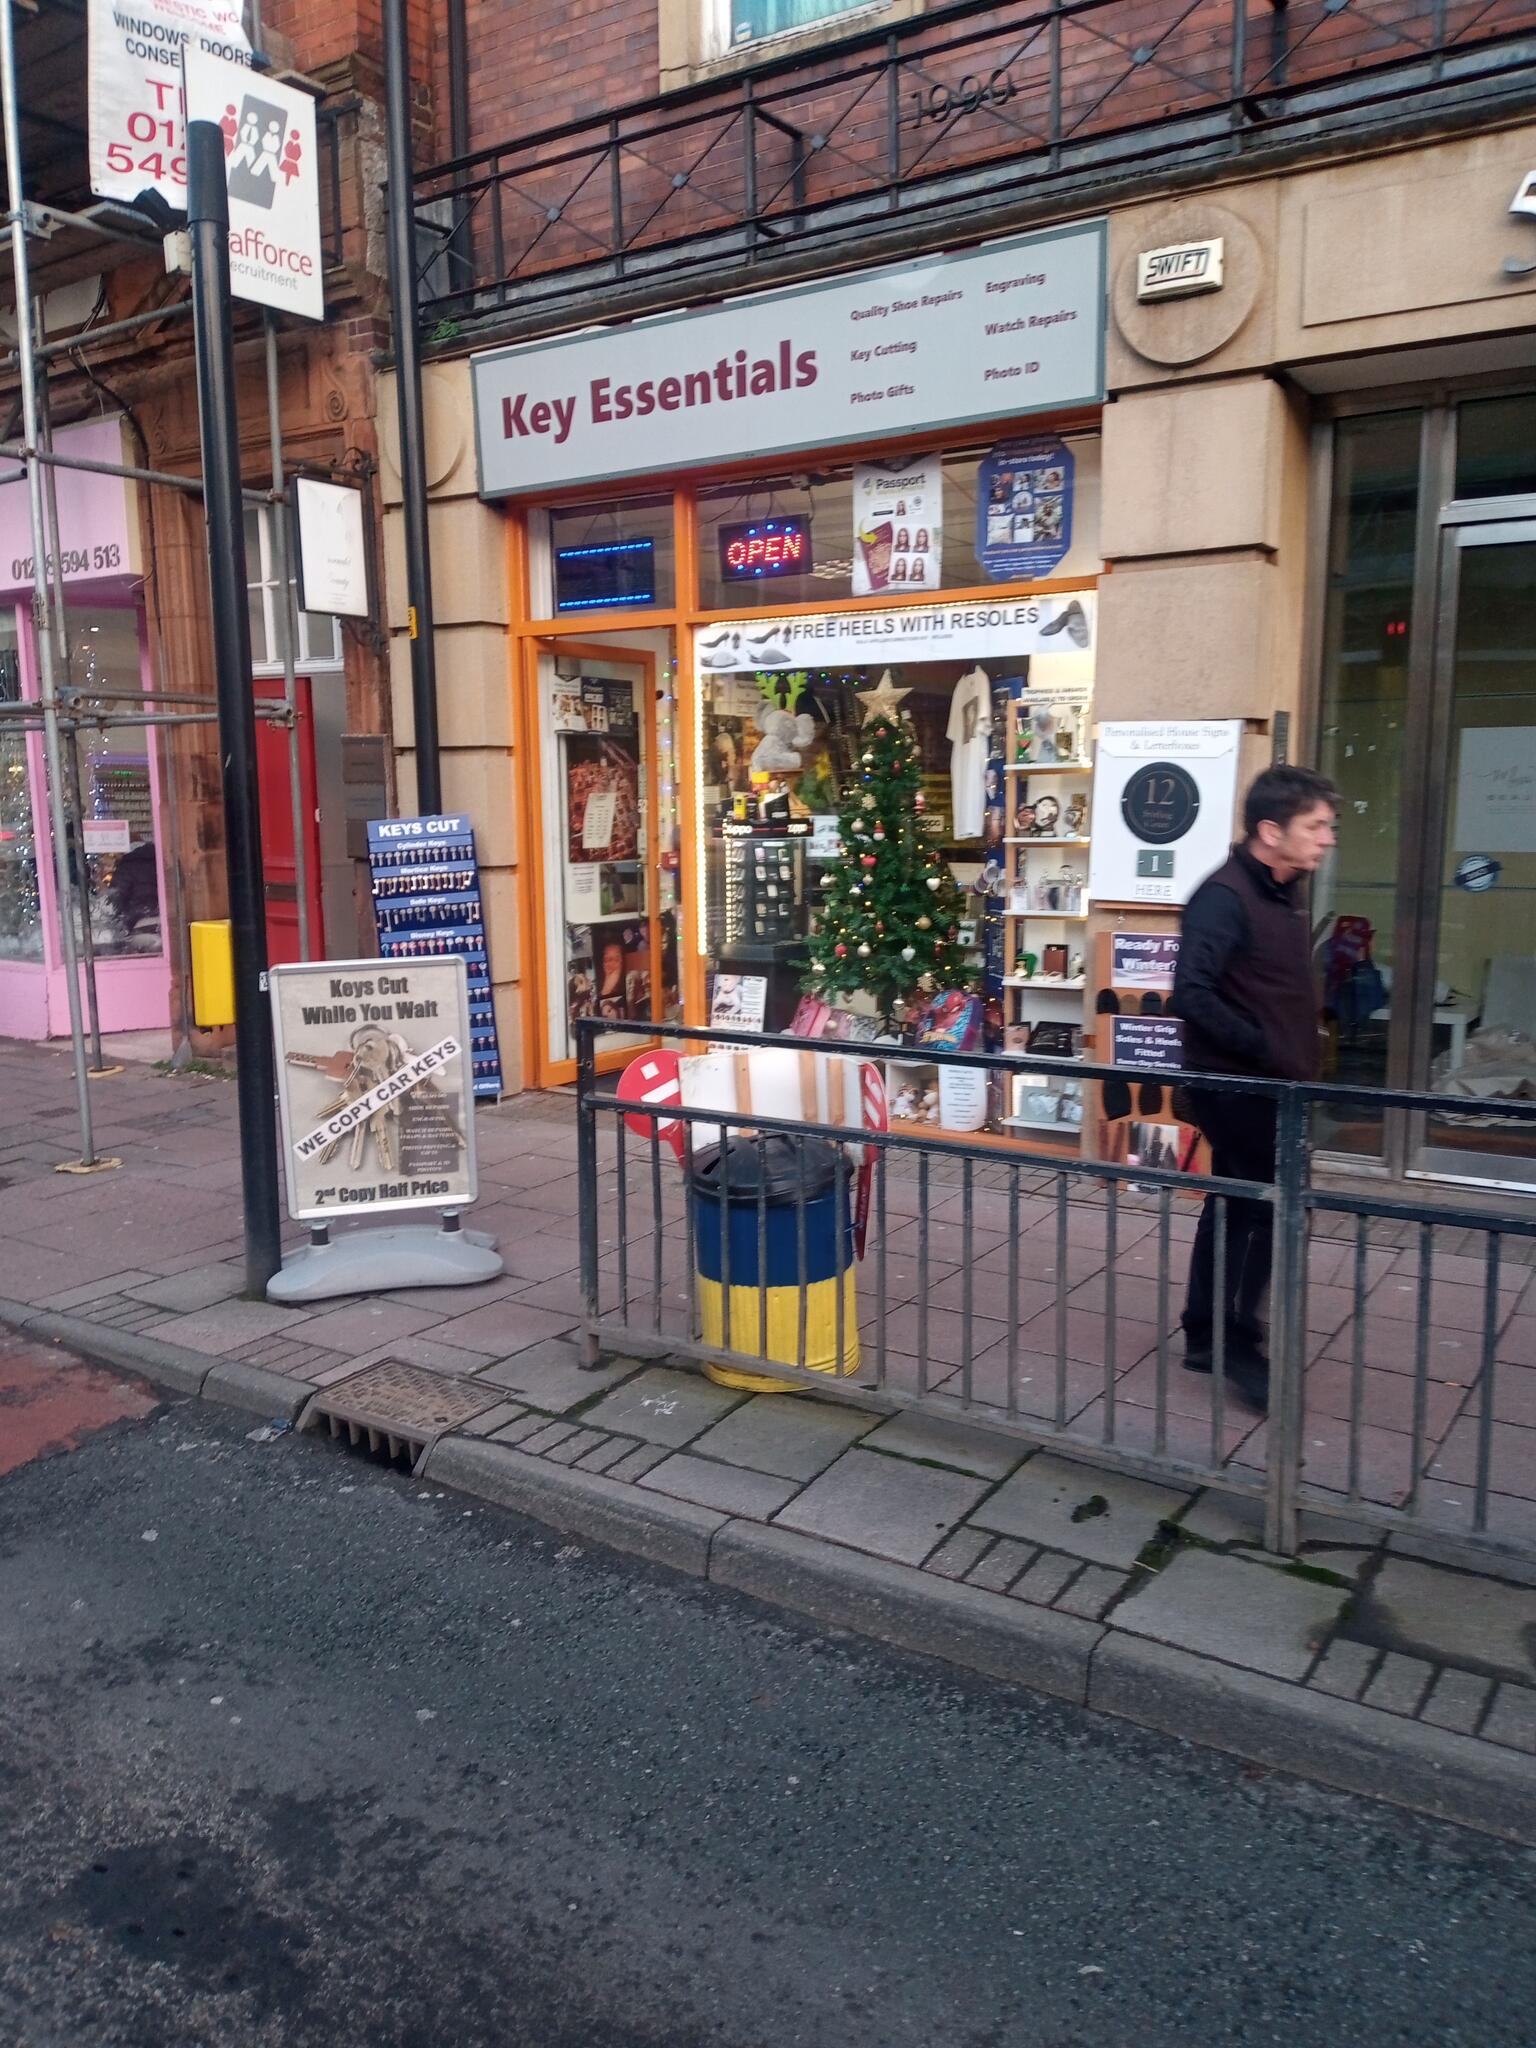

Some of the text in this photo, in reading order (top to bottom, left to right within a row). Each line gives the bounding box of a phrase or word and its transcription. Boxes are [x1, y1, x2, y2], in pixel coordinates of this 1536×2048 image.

[113, 11, 190, 45] WINDOWS
[200, 38, 253, 67] DOORS
[125, 38, 181, 68] CONSE
[127, 112, 186, 150] 01
[229, 228, 313, 277] afforce
[230, 259, 298, 290] ecruitment
[1145, 248, 1211, 286] SWIFT
[985, 271, 1047, 294] Engraving
[850, 287, 963, 321] Quality Shoe Repairs
[984, 308, 1078, 335] Watch Repairs
[850, 340, 918, 362] Key Cutting
[984, 361, 1040, 381] Photo ID
[501, 339, 818, 444] Key Essentials
[850, 382, 915, 404] Photo Gifts
[875, 473, 927, 491] Passport
[61, 549, 89, 574] 594
[94, 544, 120, 569] 513
[727, 533, 802, 565] OPEN
[792, 619, 837, 640] FREE
[839, 616, 894, 637] HEELS
[899, 614, 945, 633] WITH
[951, 607, 1039, 629] RESOLES
[1143, 778, 1177, 805] 12
[379, 819, 460, 838] KEYS CUT
[427, 839, 447, 849] Keys
[429, 864, 448, 873] Keys
[427, 896, 446, 905] Keys
[1135, 884, 1173, 897] HERE
[1113, 938, 1180, 954] Ready Fo
[1121, 956, 1178, 973] Winter?
[330, 976, 409, 998] Keys Cut
[301, 1000, 439, 1025] While You Wait
[1119, 1022, 1153, 1033] Winter
[297, 1040, 457, 1156] WE COPY CAR KEYS
[314, 1178, 450, 1205] 2nd Copy Half Price
